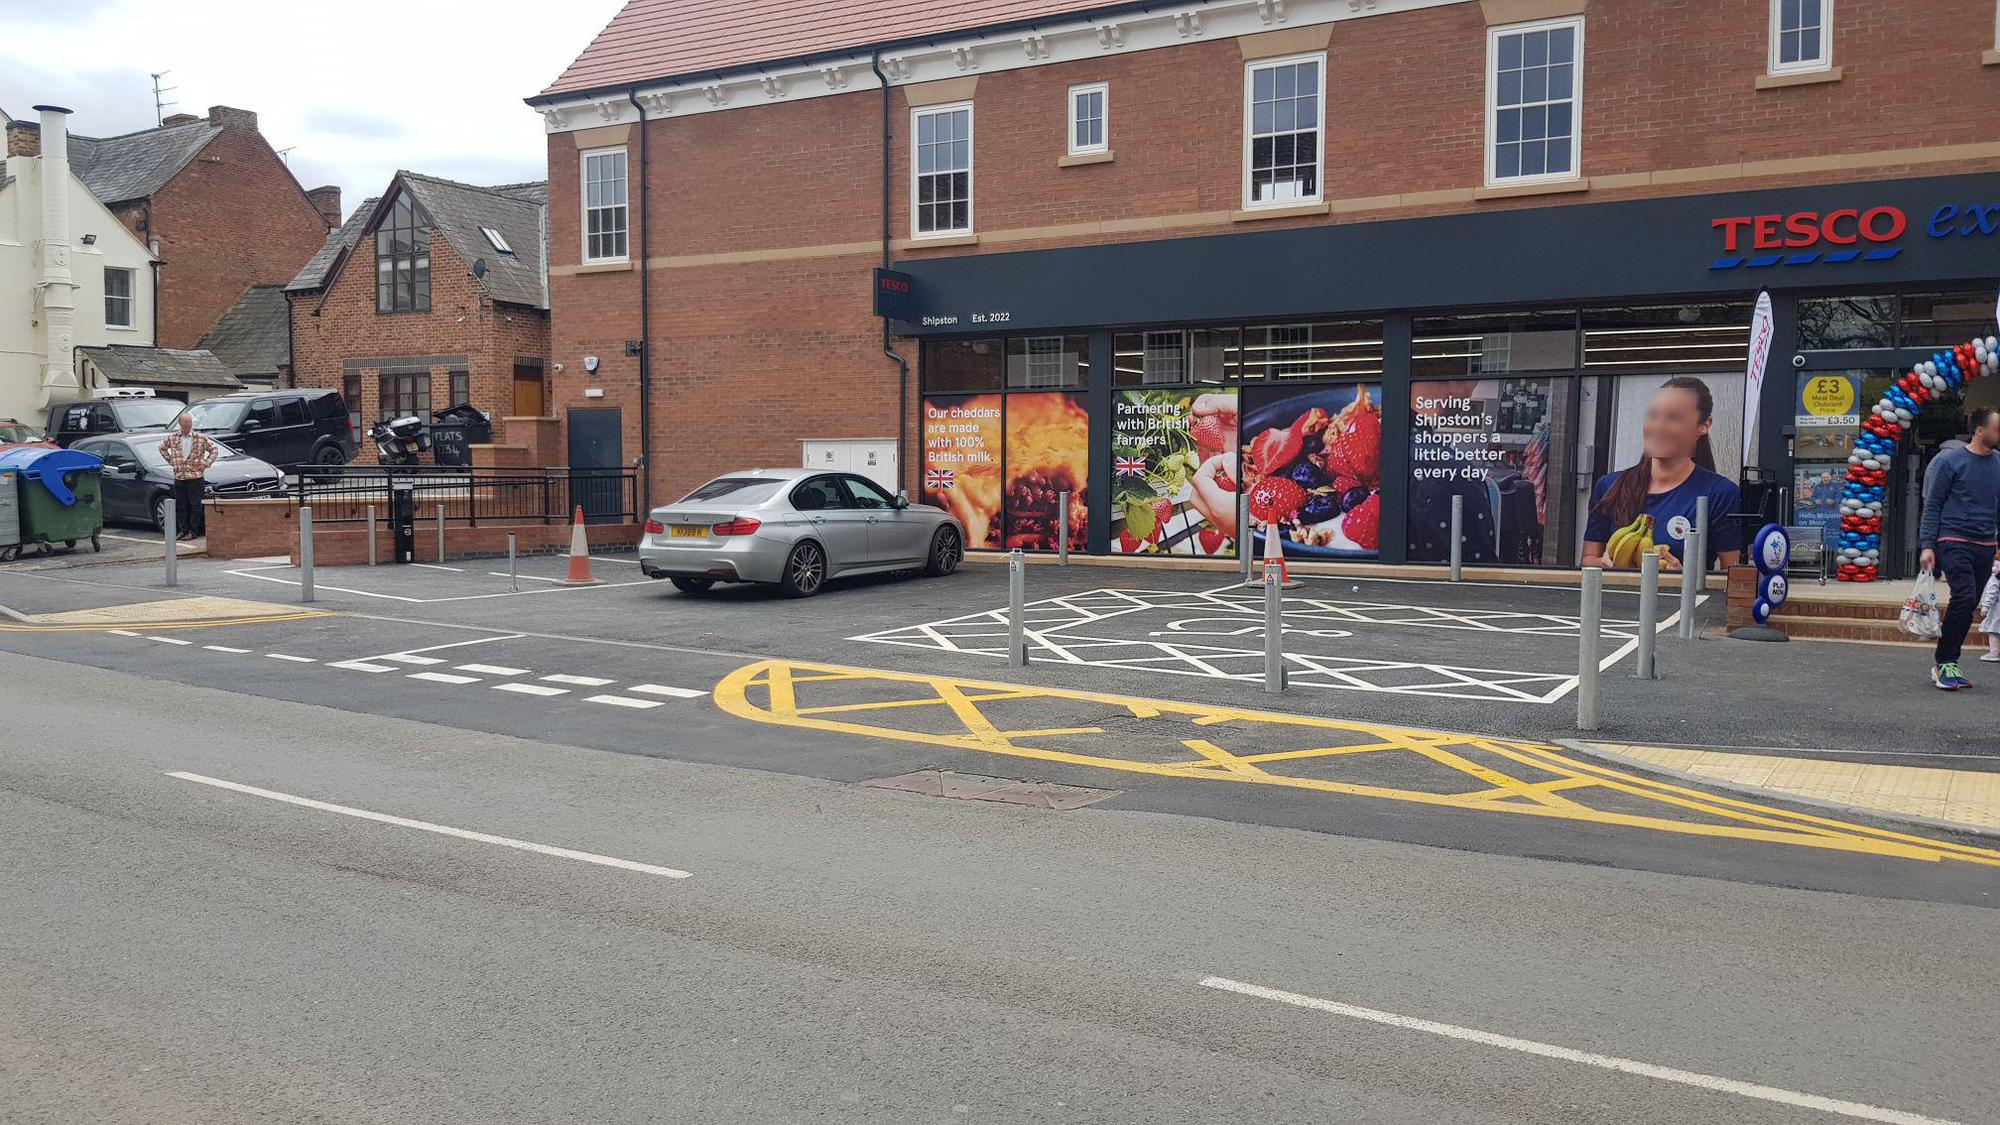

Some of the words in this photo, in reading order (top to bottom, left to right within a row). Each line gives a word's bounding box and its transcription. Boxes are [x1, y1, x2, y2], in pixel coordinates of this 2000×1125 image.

[1711, 206, 1907, 251] TESCO
[882, 278, 908, 292] TESCO
[922, 315, 958, 327] Shipston
[972, 314, 988, 323] Est.
[989, 312, 1010, 322] 2022
[1817, 379, 1840, 394] £3
[1117, 402, 1181, 416] Partnering
[1415, 395, 1471, 411] Serving
[928, 408, 949, 419] Our
[951, 407, 1001, 419] cheddars
[1415, 412, 1493, 428] Shipston's
[928, 424, 946, 433] are
[949, 422, 980, 433] made
[1117, 418, 1144, 430] with
[1148, 418, 1190, 430] British
[1827, 416, 1855, 425] £3.50
[434, 431, 463, 441] FLATS
[928, 437, 952, 448] with
[955, 437, 985, 448] 100%
[1117, 434, 1166, 445] farmers
[1414, 430, 1488, 447] shoppers
[1490, 432, 1501, 443] a
[928, 451, 964, 462] British
[1414, 447, 1451, 461] little
[1454, 447, 1505, 461] better
[1413, 467, 1457, 481] every
[1460, 464, 1489, 481] day
